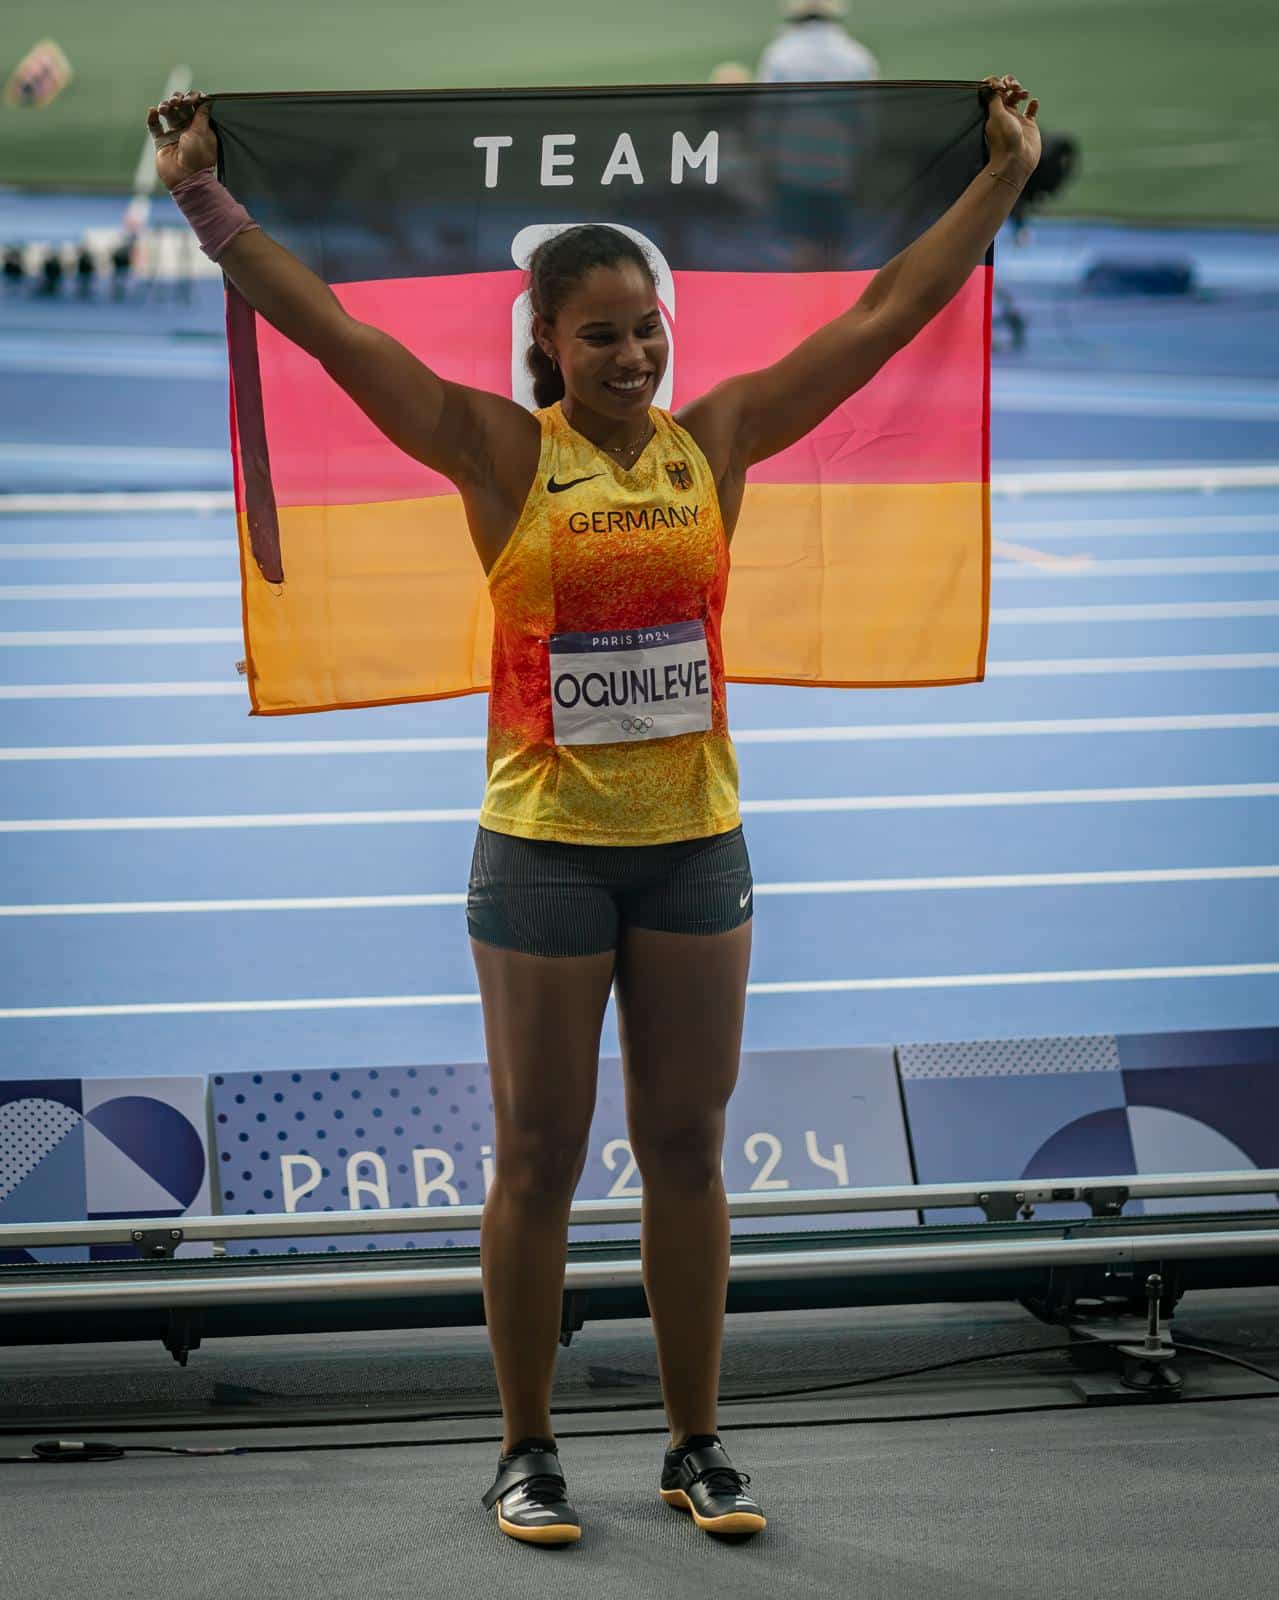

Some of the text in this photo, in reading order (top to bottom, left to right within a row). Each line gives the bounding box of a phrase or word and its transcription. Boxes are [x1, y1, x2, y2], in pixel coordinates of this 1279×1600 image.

[473, 130, 719, 188] TEAM
[568, 504, 699, 534] GERMANY
[638, 631, 671, 644] 2024
[554, 659, 709, 709] OGUNLEYE
[280, 1131, 849, 1213] PARi 224
